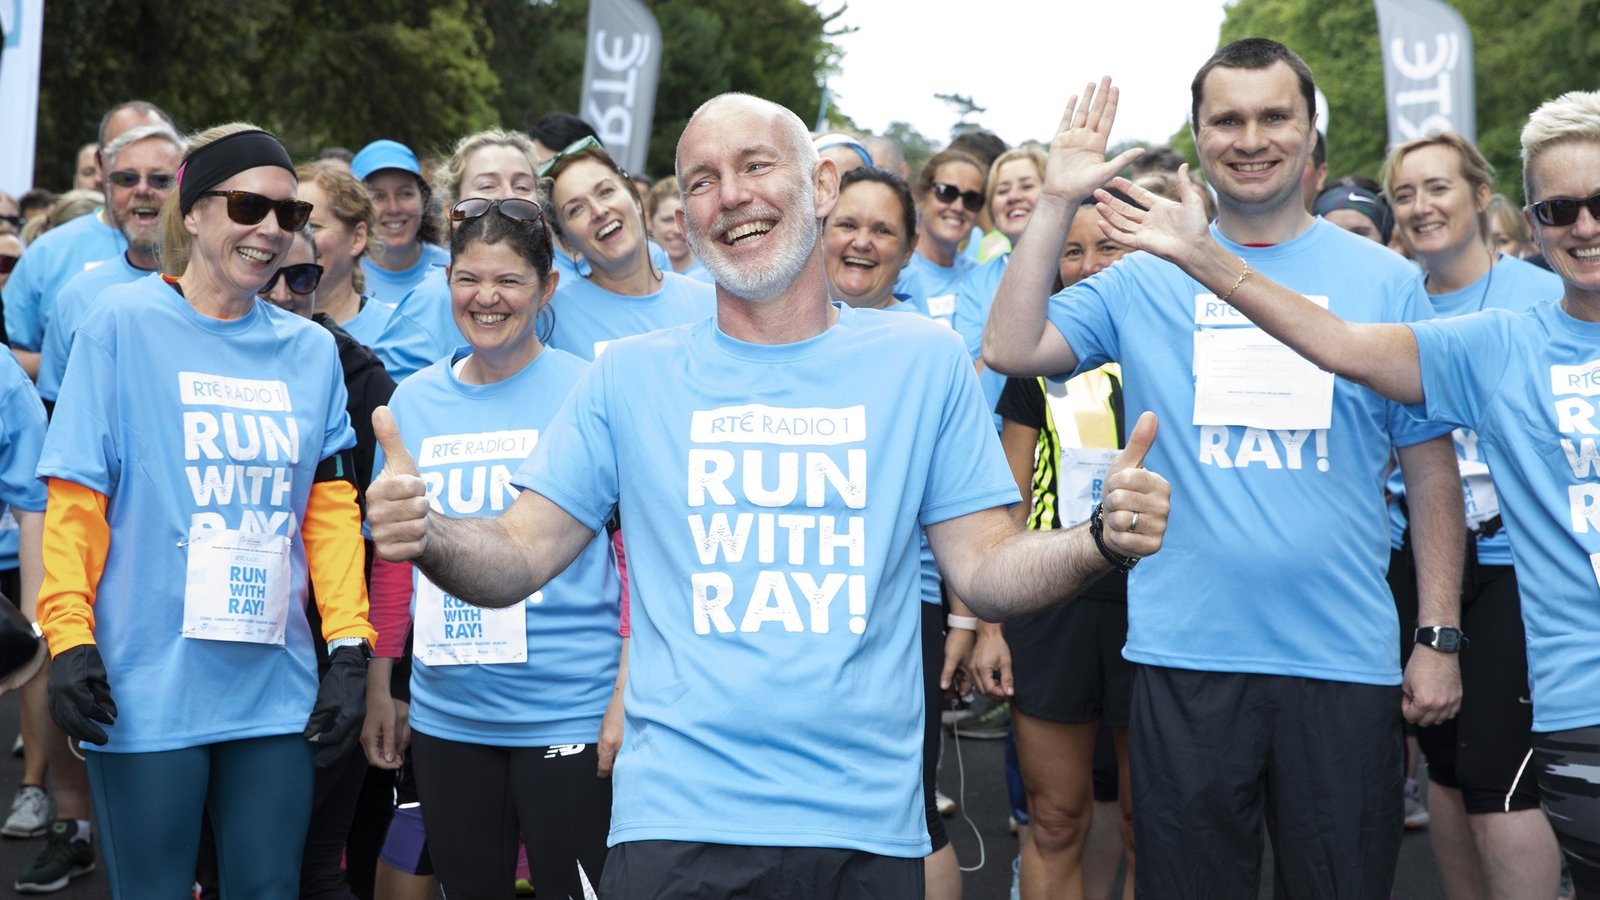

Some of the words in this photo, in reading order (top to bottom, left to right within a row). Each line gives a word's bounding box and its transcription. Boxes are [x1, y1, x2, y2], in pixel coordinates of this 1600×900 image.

[193, 380, 223, 399] RTÉ
[225, 384, 272, 403] RADIO
[275, 389, 283, 403] 1
[711, 411, 755, 434] RTÉ
[762, 415, 836, 436] RADIO
[843, 417, 850, 434] 1
[183, 411, 300, 464] RUN
[431, 440, 462, 459] RTÉ
[464, 437, 516, 455] RADIO
[520, 436, 526, 451] 1
[1199, 425, 1330, 472] RAY!
[184, 465, 292, 506] WITH
[420, 464, 522, 514] RUN
[688, 449, 867, 509] RUN
[687, 512, 865, 567] WITH
[229, 566, 267, 584] RUN
[229, 583, 266, 599] WITH
[443, 592, 471, 609] RU
[691, 570, 867, 635] RAY!
[228, 598, 265, 616] RAY!
[443, 608, 482, 622] WITH
[444, 622, 483, 639] RAY!
